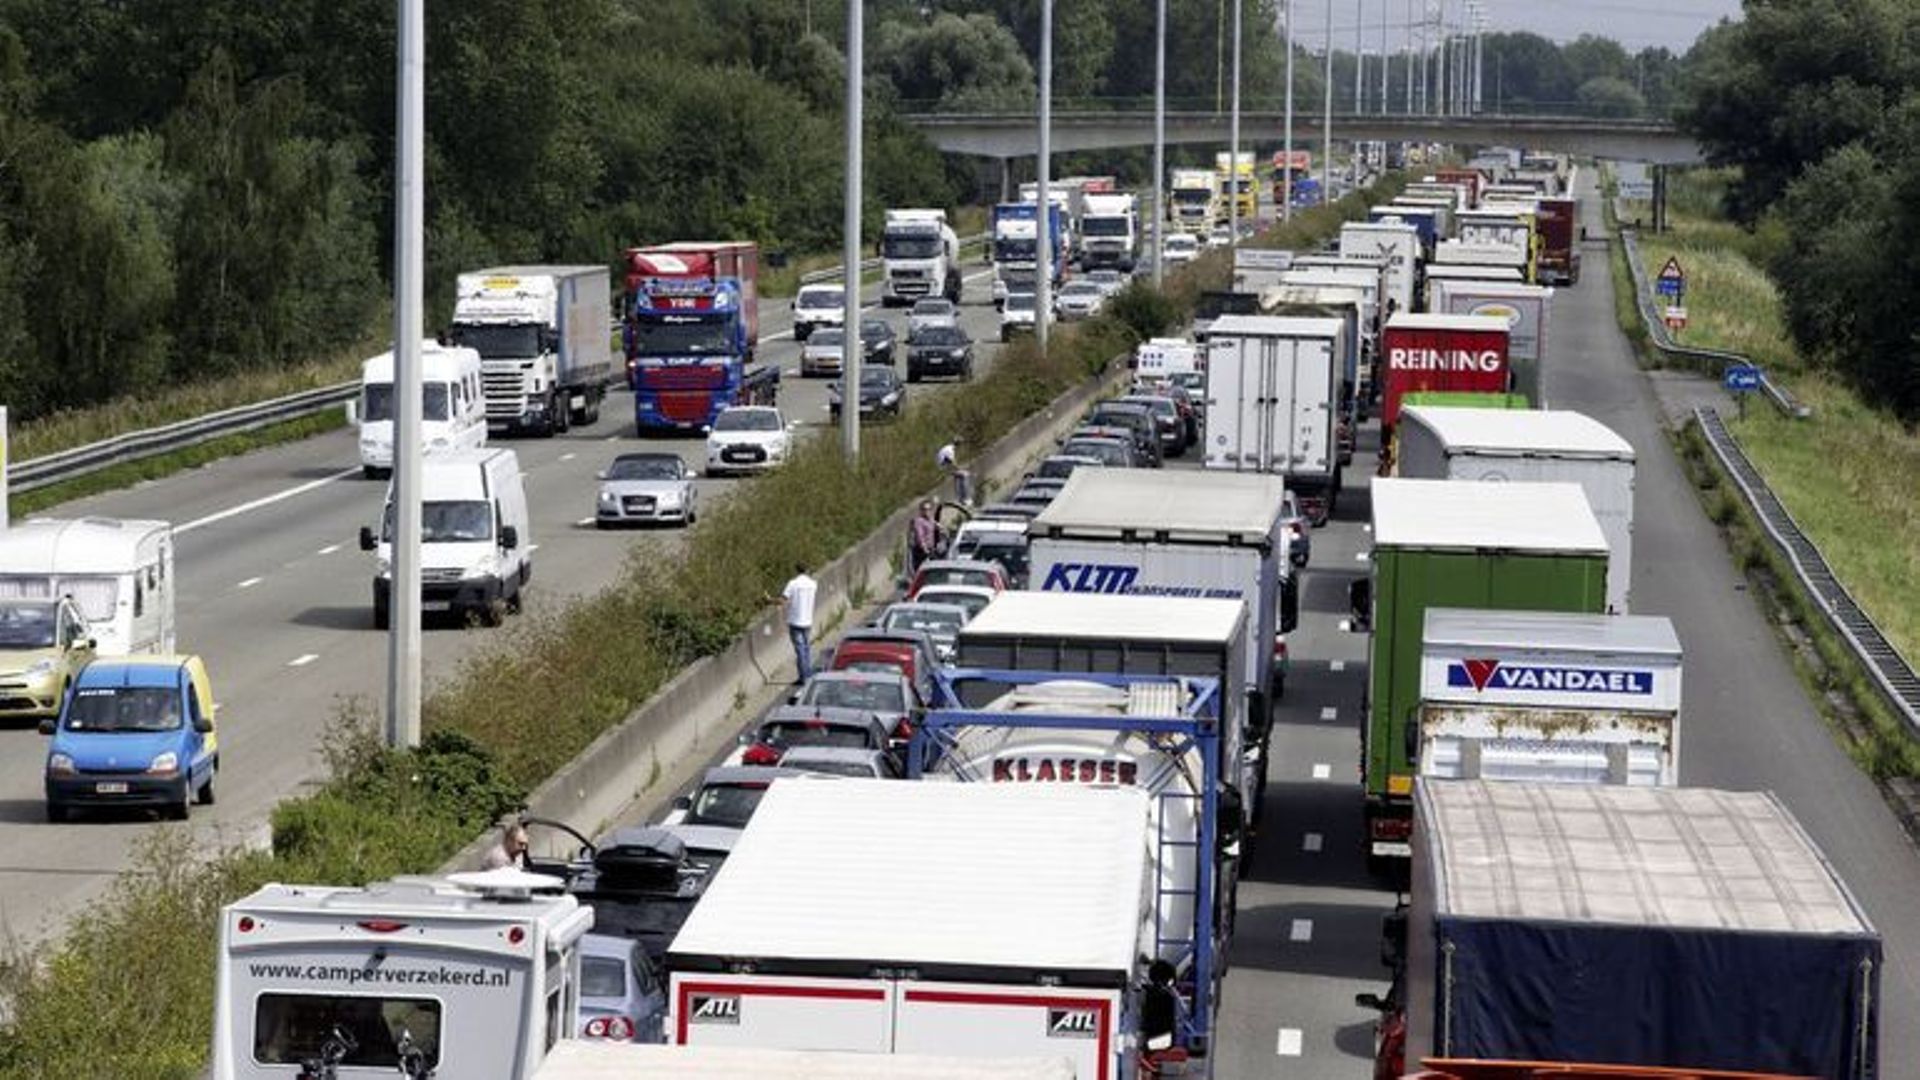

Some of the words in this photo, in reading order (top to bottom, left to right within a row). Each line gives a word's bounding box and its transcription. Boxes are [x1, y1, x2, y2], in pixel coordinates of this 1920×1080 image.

[1390, 348, 1500, 372] REINING
[1500, 670, 1643, 691] VANDAEL
[993, 758, 1137, 785] KLAESER
[250, 963, 510, 986] www.camperverzekerd.nl
[694, 998, 737, 1016] ATL
[1053, 1011, 1095, 1031] ATL
